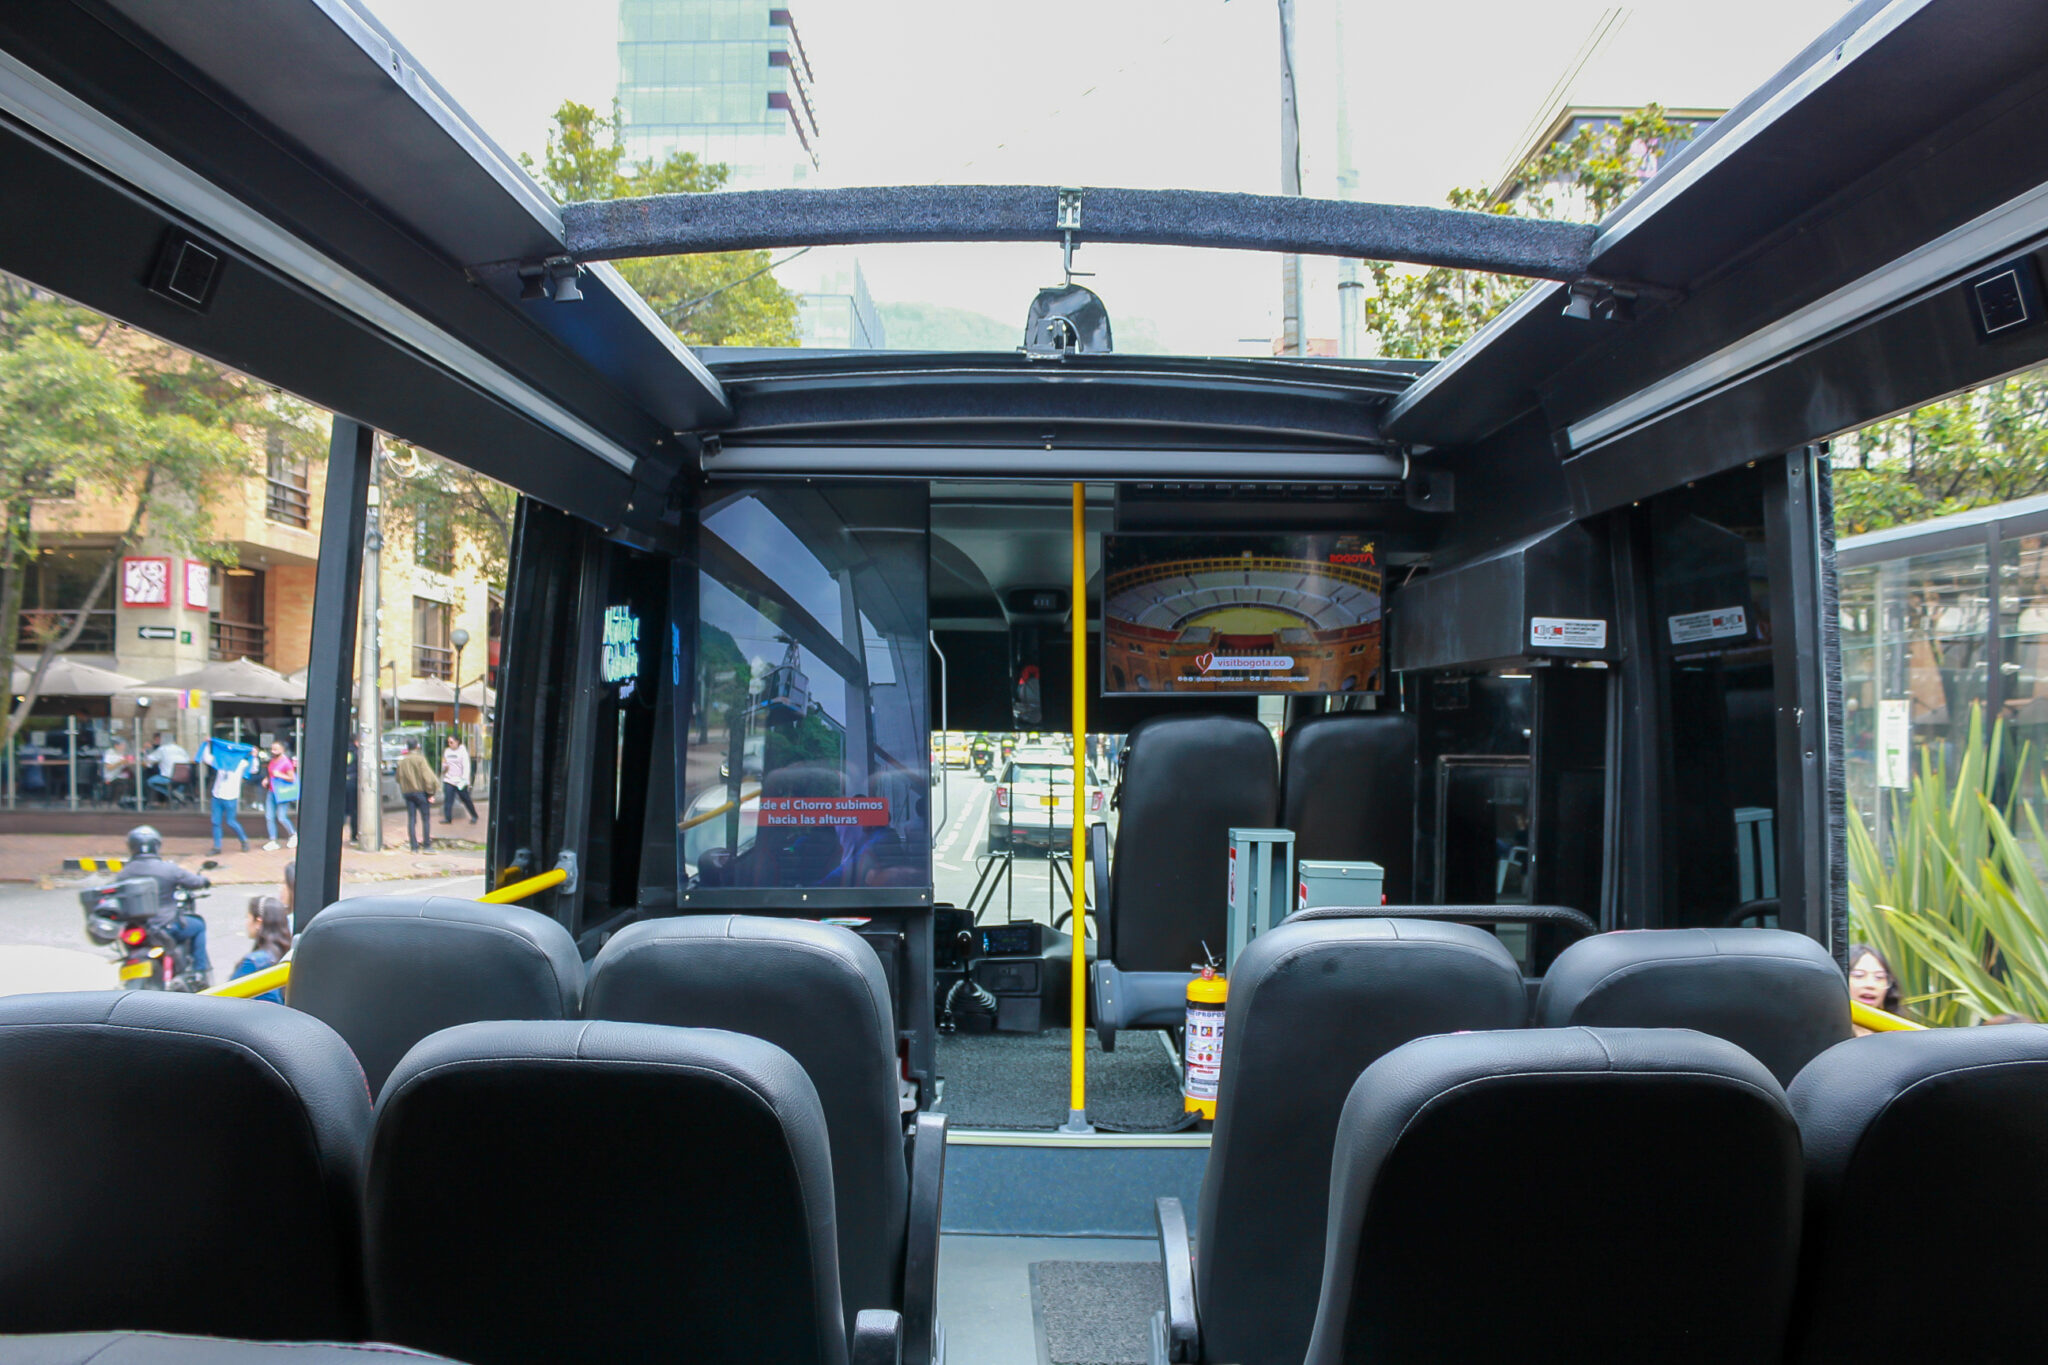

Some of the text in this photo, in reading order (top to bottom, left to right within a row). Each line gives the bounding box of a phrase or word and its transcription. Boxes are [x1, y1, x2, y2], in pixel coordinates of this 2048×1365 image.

[1217, 658, 1286, 668] visitbogota.co
[780, 800, 790, 810] el
[793, 799, 832, 810] Chorro
[835, 799, 883, 810] subimos
[767, 814, 858, 824] hacia las alturas
